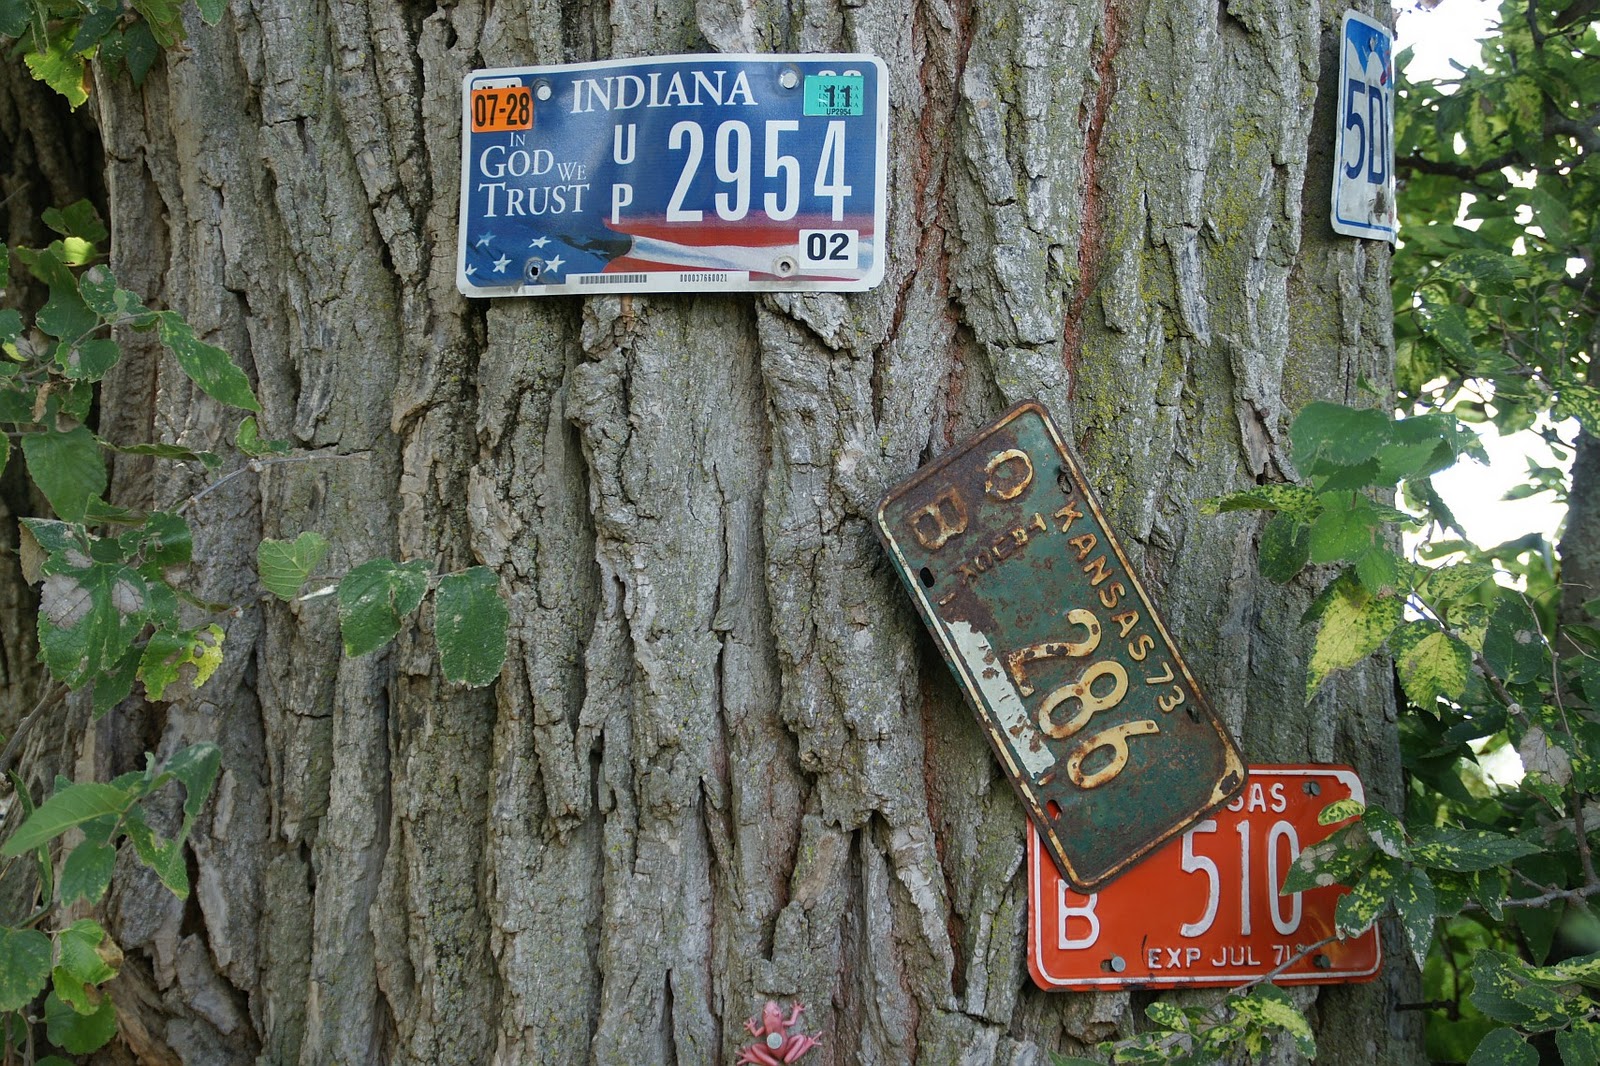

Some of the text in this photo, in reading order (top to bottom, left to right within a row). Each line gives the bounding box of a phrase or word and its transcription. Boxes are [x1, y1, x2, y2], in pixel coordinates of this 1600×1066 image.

[475, 92, 530, 127] 07-28
[570, 70, 758, 114] INDIANA
[824, 85, 850, 107] 11
[510, 132, 526, 147] IN
[479, 145, 587, 181] GOD WE
[666, 119, 852, 222] 2954
[478, 181, 590, 218] TRUST
[806, 232, 850, 261] 02
[1054, 501, 1185, 712] KANSAS 73
[1007, 607, 1160, 789] 286
[1180, 820, 1303, 938] 510
[1058, 879, 1100, 950] B
[1147, 948, 1201, 969] EXP
[1211, 945, 1262, 967] JUL
